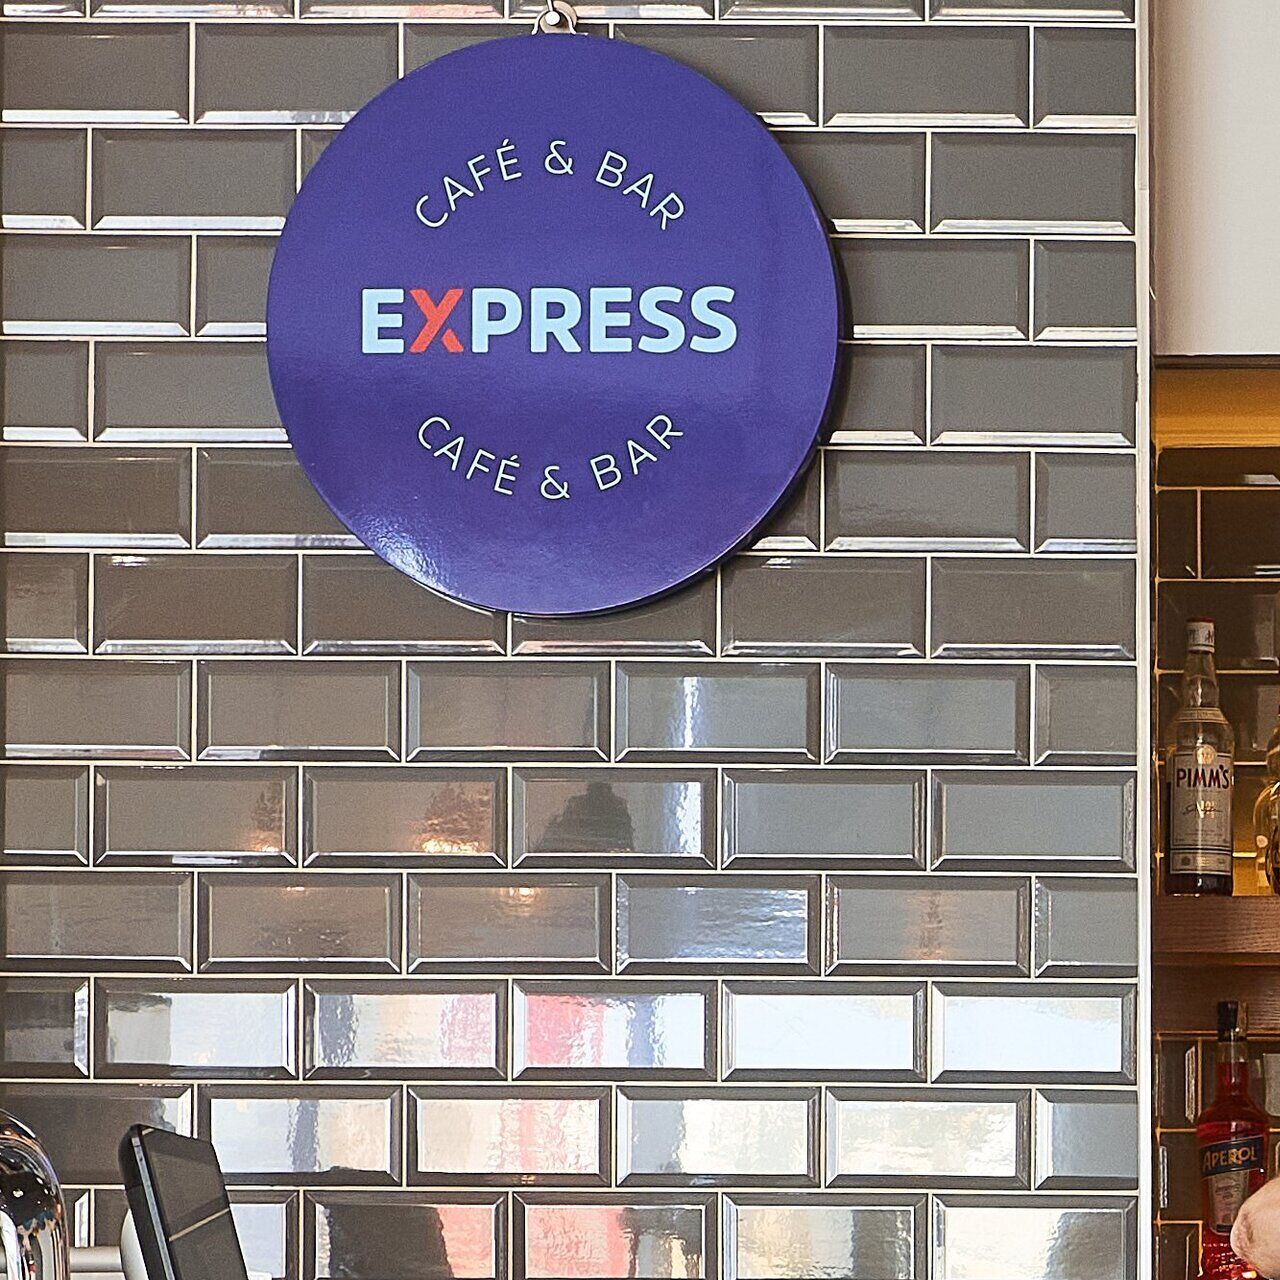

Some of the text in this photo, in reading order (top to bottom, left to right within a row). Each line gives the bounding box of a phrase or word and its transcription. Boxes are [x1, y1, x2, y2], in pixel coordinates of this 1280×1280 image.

[415, 138, 685, 230] CAFÉ & BAR
[361, 286, 738, 354] EXPRESS
[417, 413, 684, 500] CAFÉ & BAR
[1176, 765, 1229, 790] PIMM'S
[1202, 1147, 1257, 1173] APEROL
